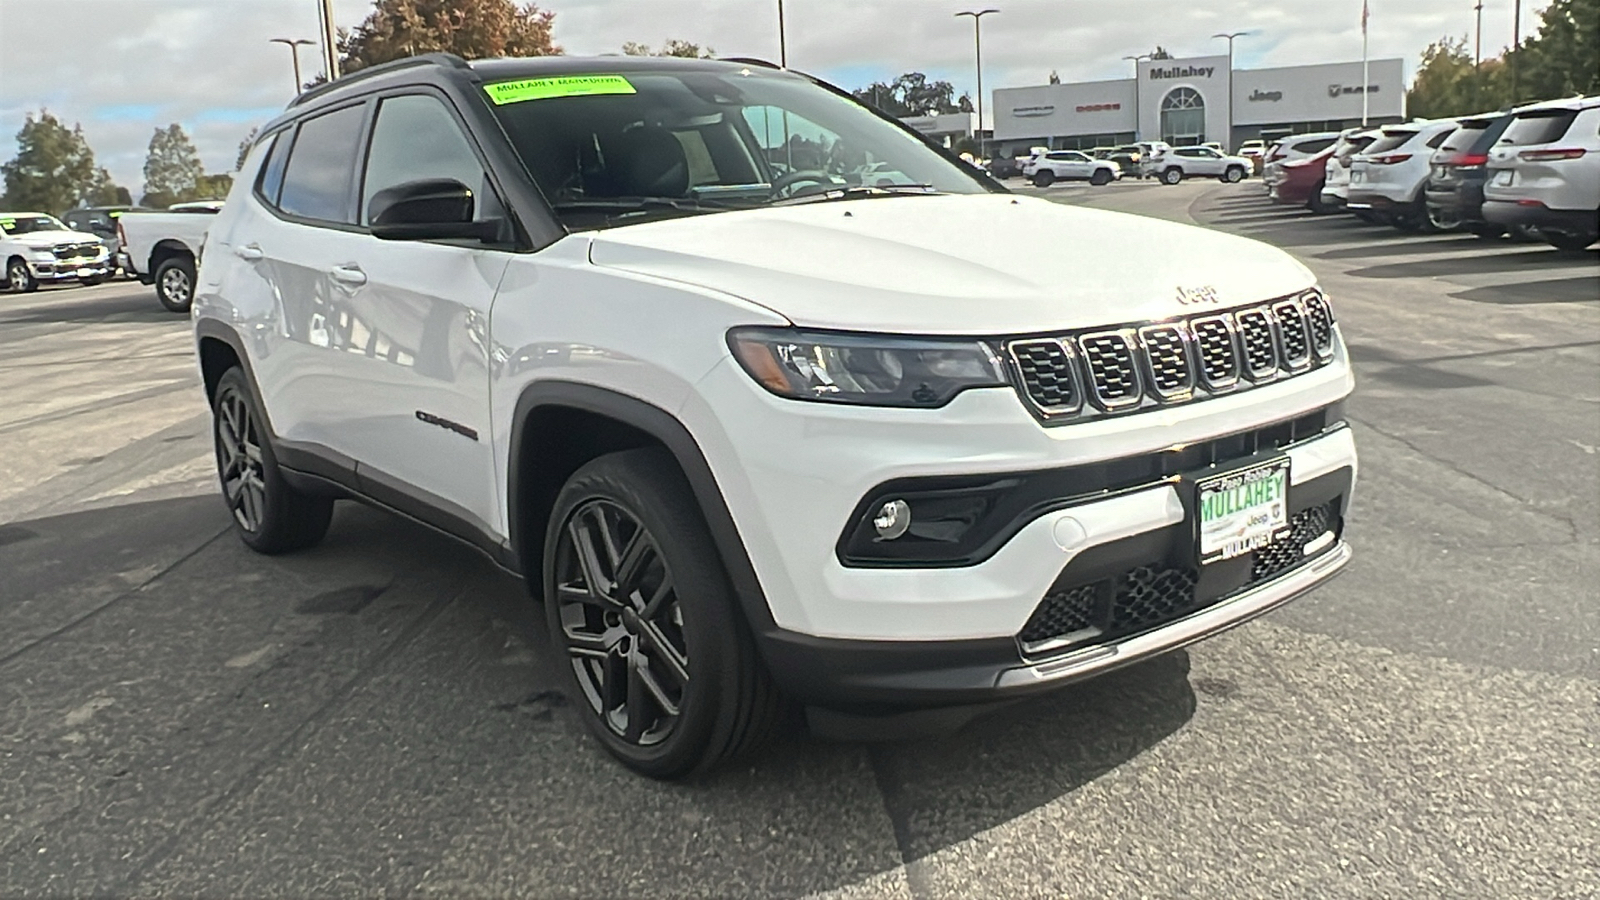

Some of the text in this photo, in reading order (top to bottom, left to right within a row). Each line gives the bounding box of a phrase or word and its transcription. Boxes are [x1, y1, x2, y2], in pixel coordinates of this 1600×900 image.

[1150, 65, 1214, 79] Mullahey
[1249, 89, 1282, 102] Jeep
[1176, 286, 1218, 305] Jeep
[1202, 475, 1284, 522] MULLAHEY
[1247, 514, 1268, 527] Jeep
